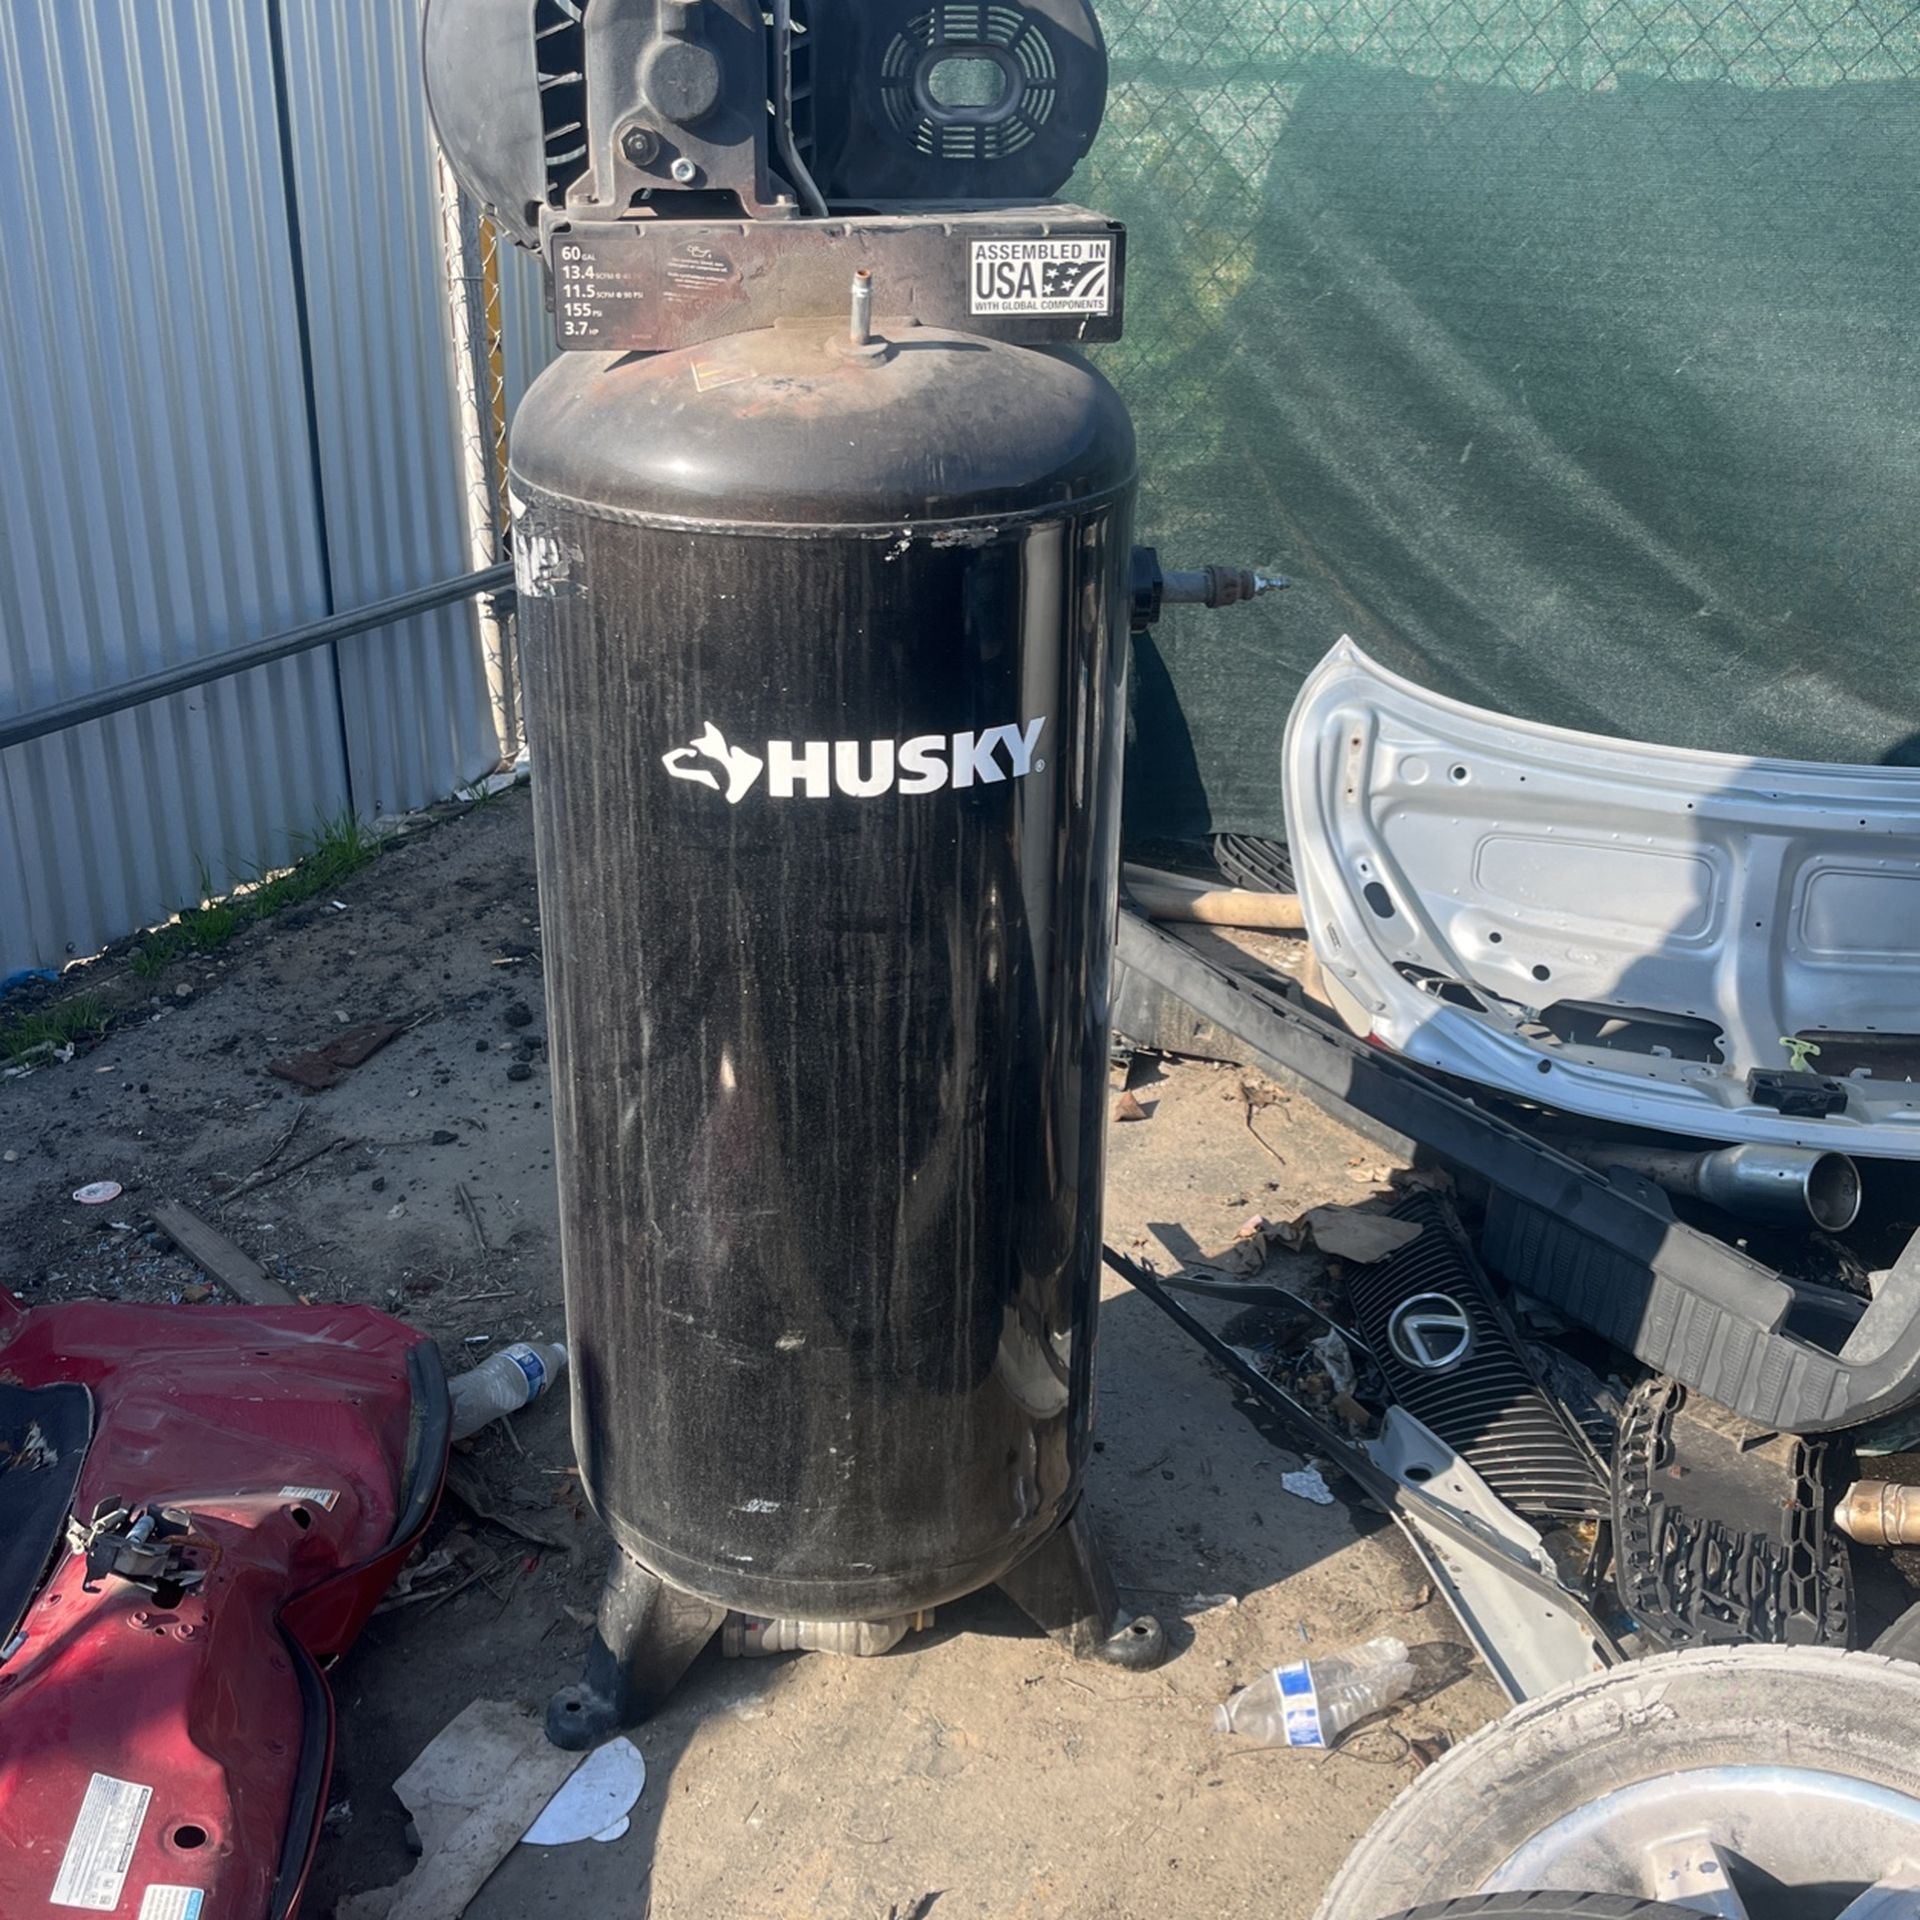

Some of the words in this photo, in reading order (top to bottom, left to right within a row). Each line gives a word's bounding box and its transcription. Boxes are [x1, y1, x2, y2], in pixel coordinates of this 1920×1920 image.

[561, 246, 581, 260] 60
[581, 253, 596, 261] GAL
[975, 244, 1082, 260] ASSEMBLED
[1089, 243, 1106, 259] IN
[562, 265, 595, 280] 13.4
[976, 261, 1037, 299] USA
[563, 284, 596, 298] 11.5
[564, 302, 592, 317] 155
[975, 302, 999, 311] WITH
[1001, 301, 1038, 311] GLOBAL
[1040, 299, 1105, 310] COMPONENTS
[564, 321, 588, 335] 3.7
[767, 716, 1046, 798] HUSKY
